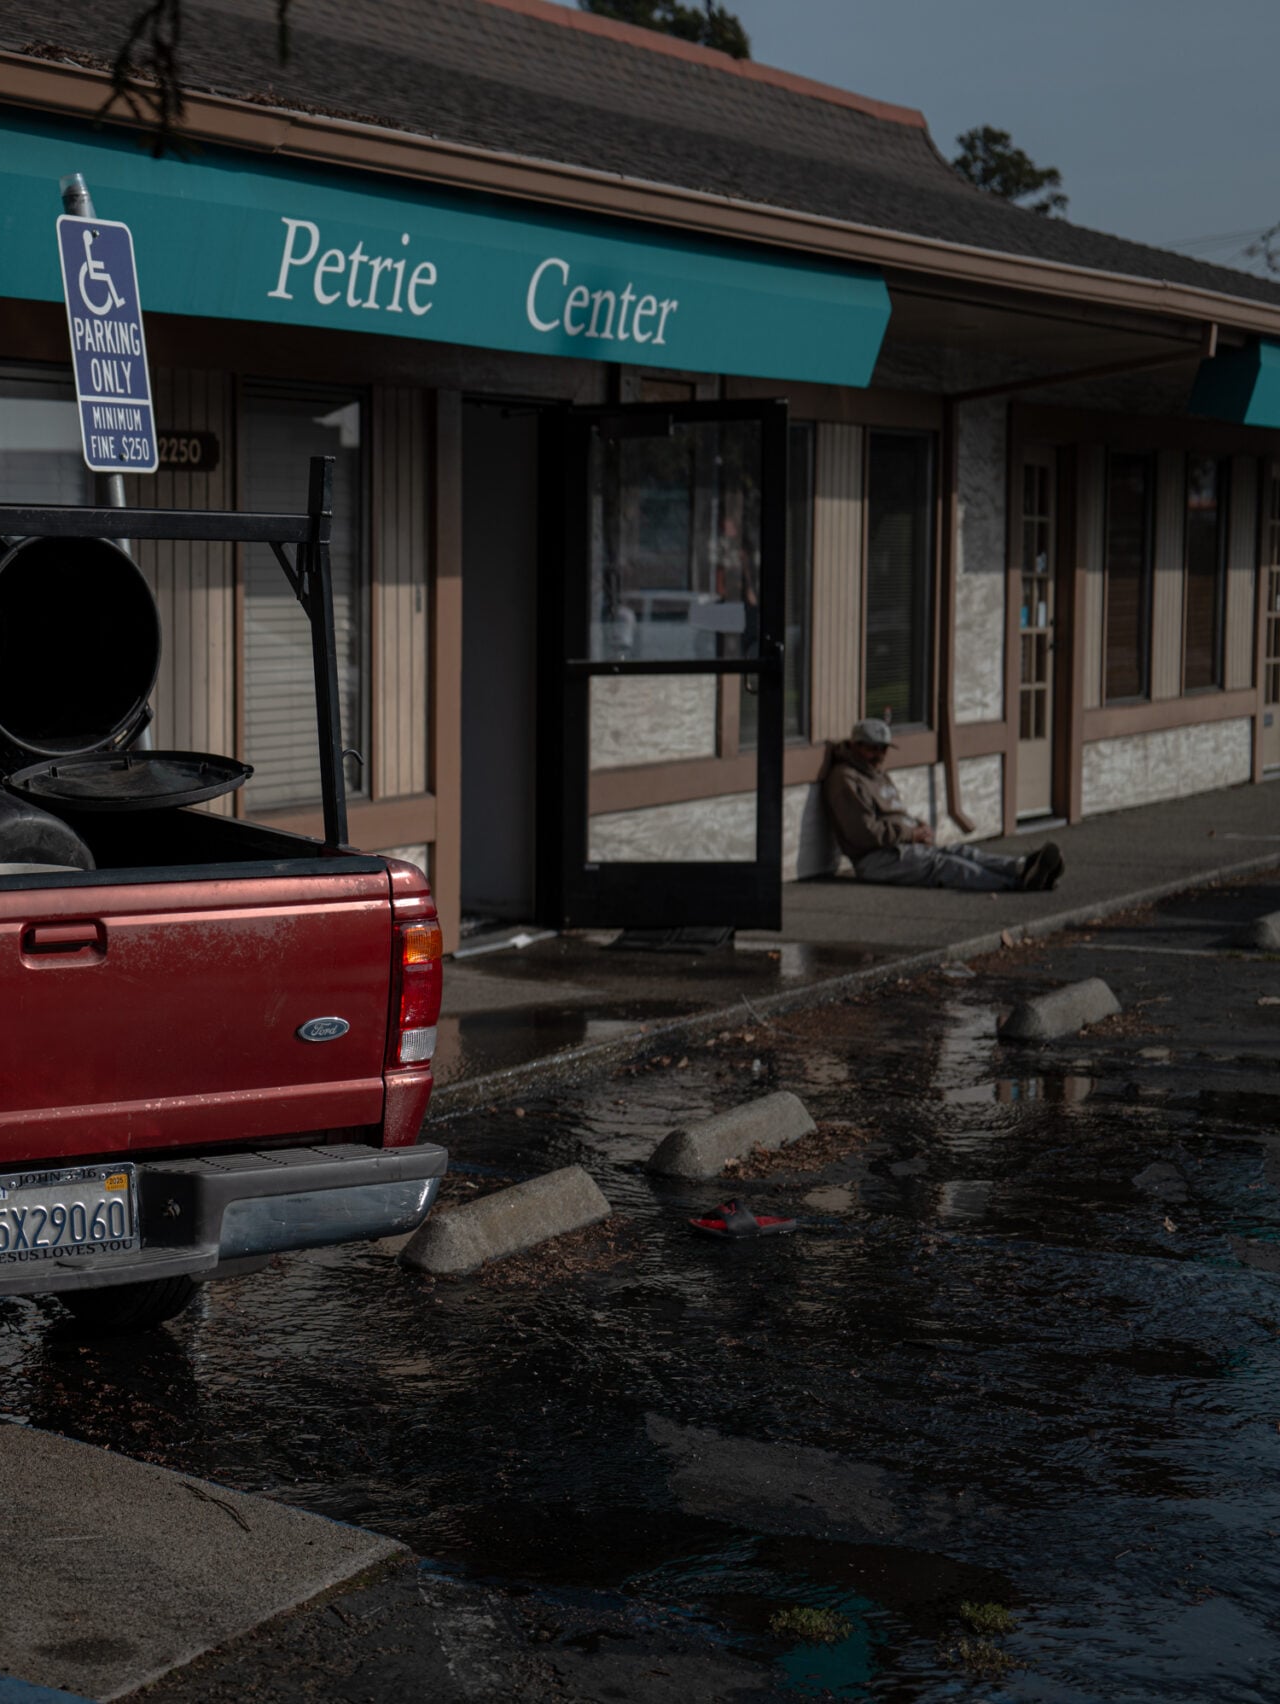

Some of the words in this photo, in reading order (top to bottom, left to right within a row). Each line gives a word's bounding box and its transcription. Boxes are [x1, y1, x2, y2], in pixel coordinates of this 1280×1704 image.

[267, 216, 438, 316] Petrie
[526, 257, 679, 345] Center
[74, 317, 141, 356] PARKING
[90, 358, 132, 394] ONLY
[92, 406, 143, 431] MINIMUM
[90, 435, 117, 459] FINE
[121, 435, 150, 462] $250
[159, 436, 202, 463] 2250
[311, 1022, 339, 1036] Ford
[19, 1171, 61, 1186] JOHN
[42, 1243, 96, 1260] LOVES
[99, 1238, 134, 1254] YOU
